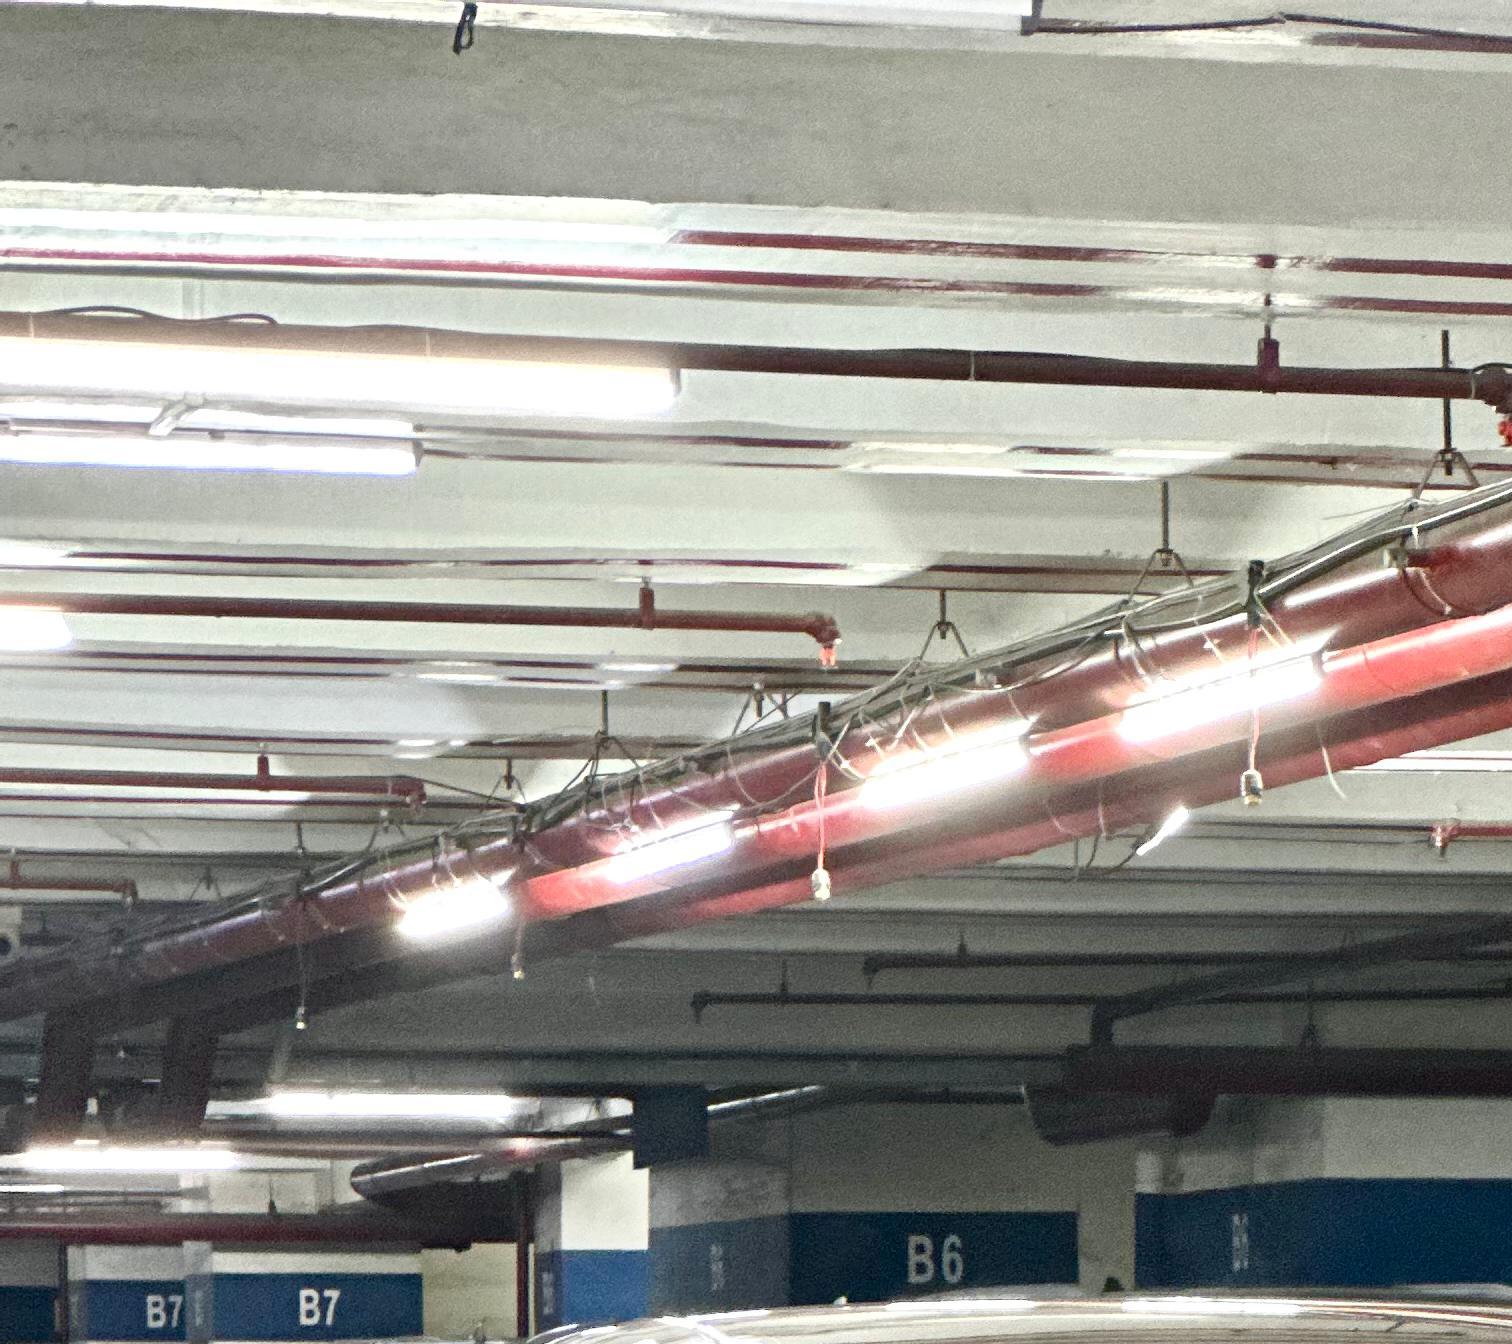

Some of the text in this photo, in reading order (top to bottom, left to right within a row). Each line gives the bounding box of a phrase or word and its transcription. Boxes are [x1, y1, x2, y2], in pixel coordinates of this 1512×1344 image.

[907, 1234, 963, 1283] B6
[146, 1294, 183, 1328] B7
[299, 1288, 341, 1327] B7
